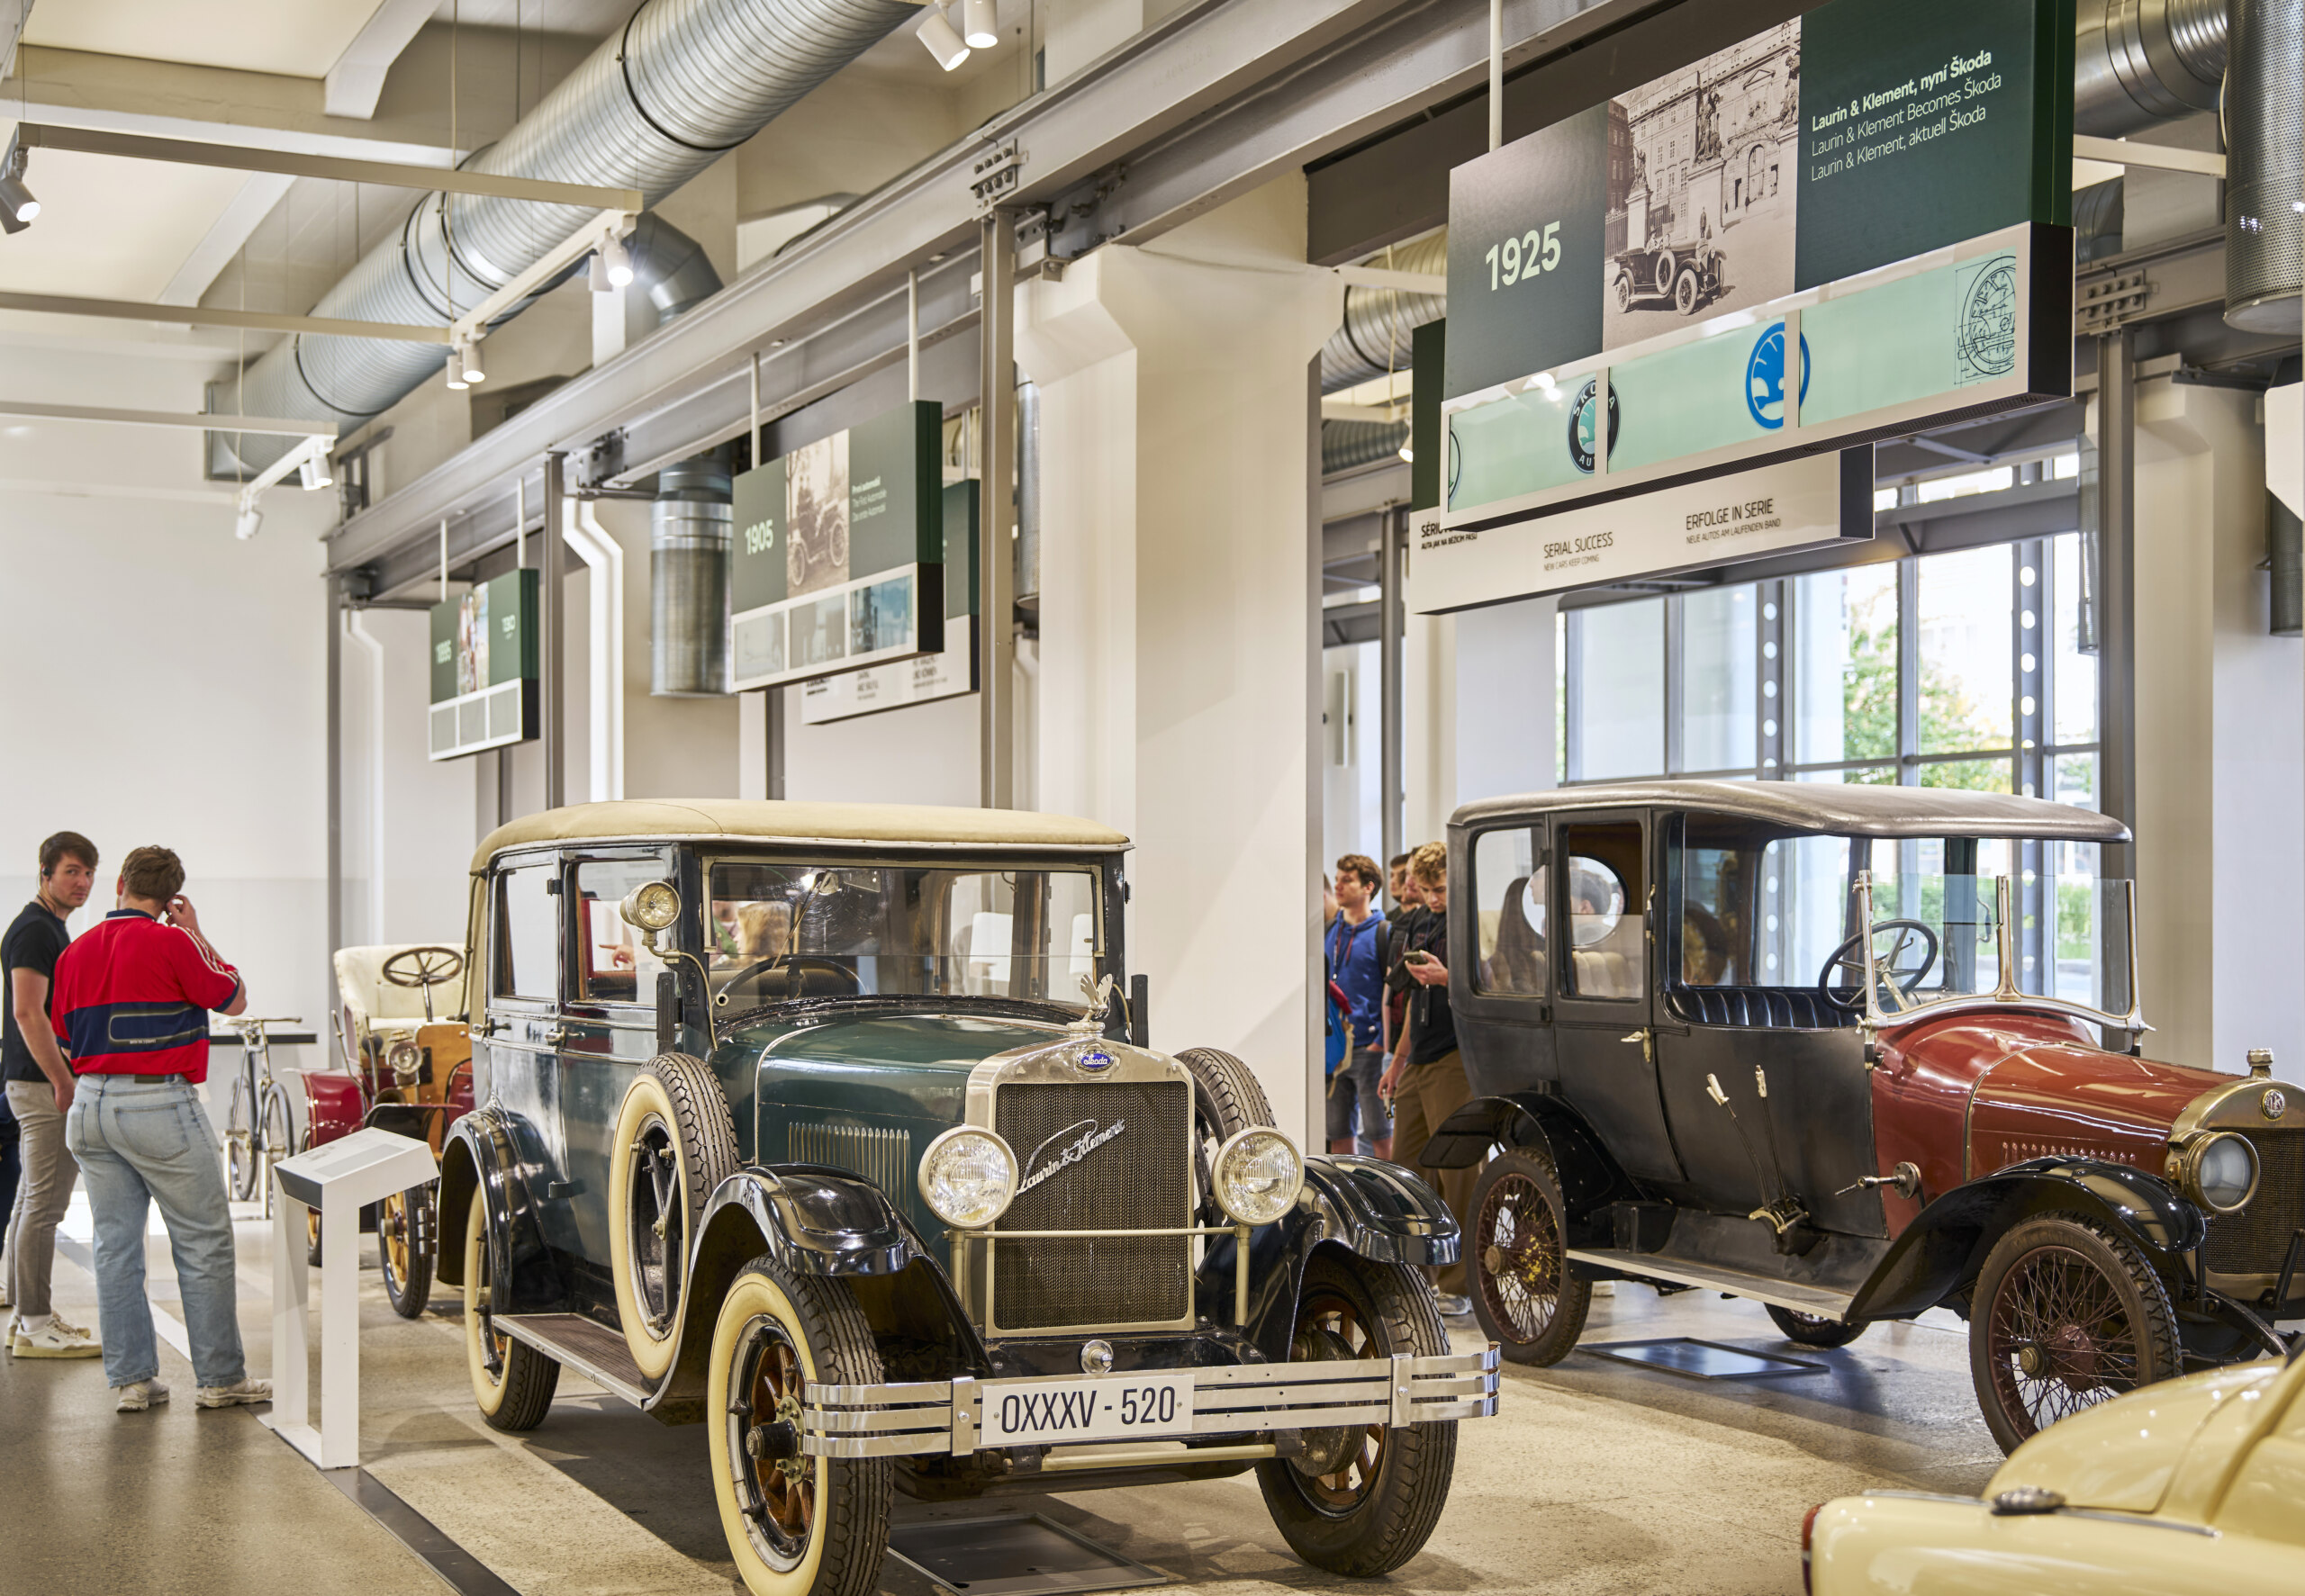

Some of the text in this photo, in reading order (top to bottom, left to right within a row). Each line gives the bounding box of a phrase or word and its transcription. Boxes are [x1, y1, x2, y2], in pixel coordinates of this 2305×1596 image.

[1812, 50, 1992, 132] Laurin & Klement, nyní Škoda
[1812, 72, 2002, 157] Laurin & Klement Becomes Škoda
[1812, 104, 1986, 182] Laurin & Klement, aktuell Škoda
[1486, 221, 1561, 292] 1925
[1686, 498, 1774, 530] ERFOLGE IN SERIE
[1686, 518, 1781, 545] NEUE AUTOS AM LAUFENDEN BAND
[745, 518, 773, 555] 1905
[1543, 531, 1614, 558] SERIAL SUCCESS
[1544, 555, 1600, 572] NEW CARS KEEP COMING
[1121, 1386, 1176, 1425] 520
